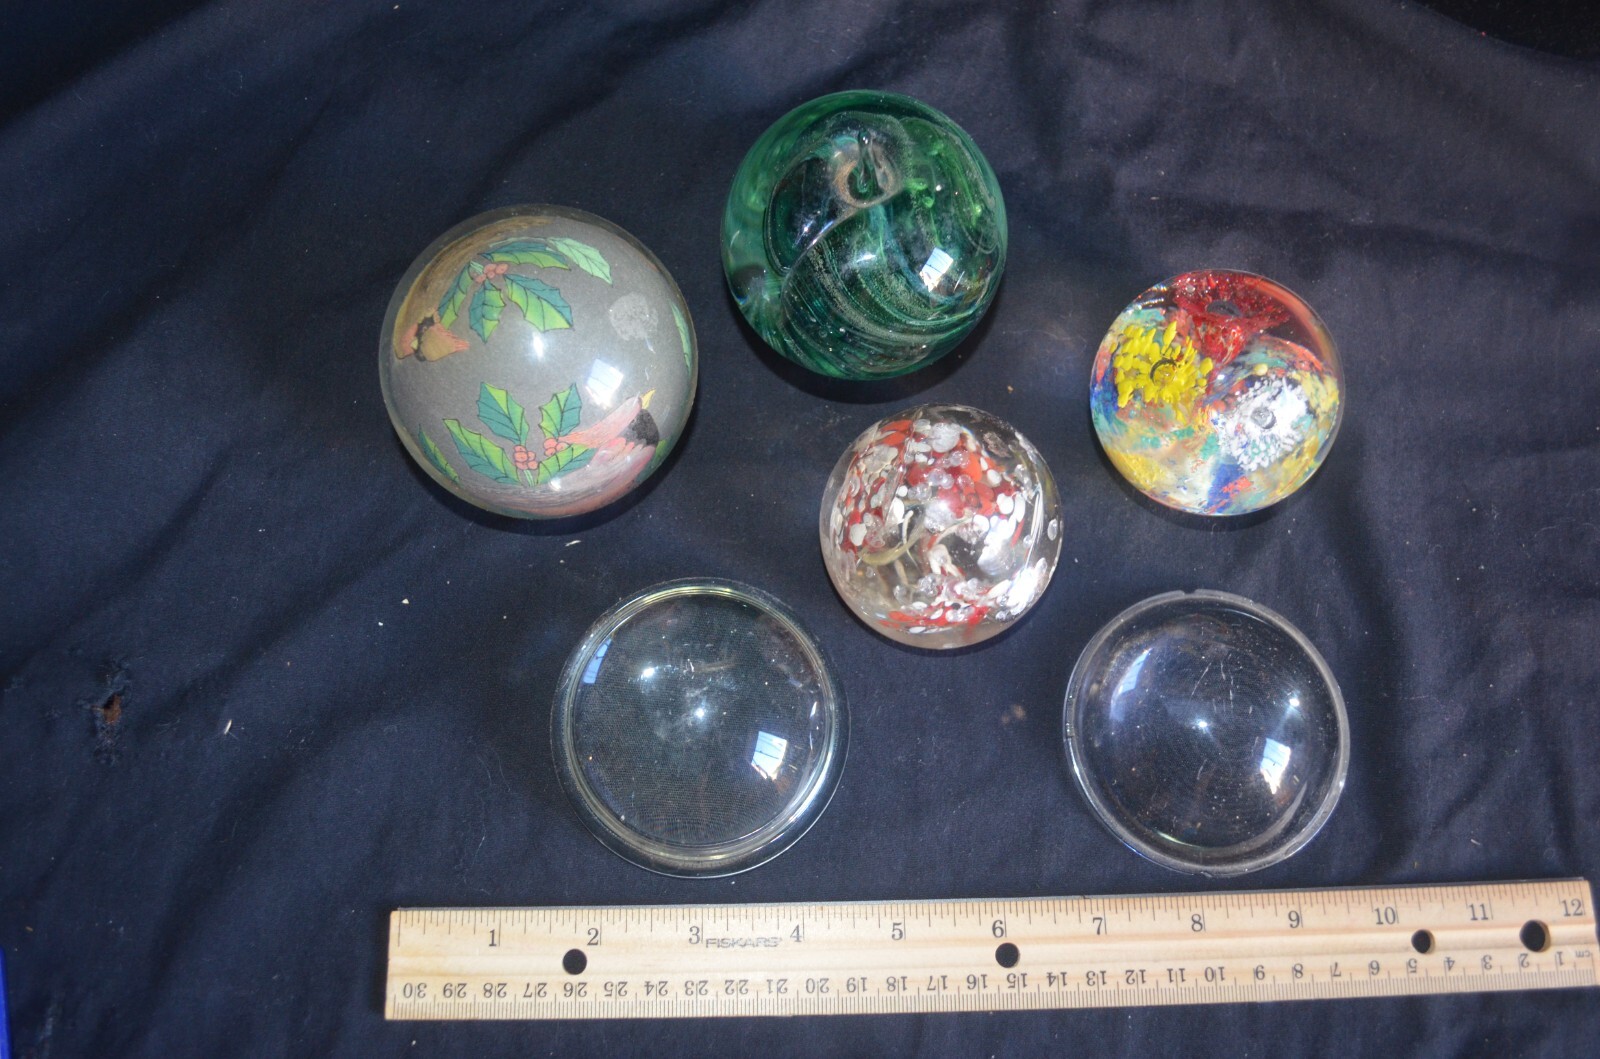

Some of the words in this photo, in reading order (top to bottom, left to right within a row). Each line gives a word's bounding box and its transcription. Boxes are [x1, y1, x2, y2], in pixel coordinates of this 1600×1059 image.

[489, 930, 497, 946] 1
[588, 928, 600, 946] 2
[688, 926, 700, 944] 3
[790, 924, 802, 942] 4
[892, 922, 904, 940] 5
[992, 920, 1004, 938] 6
[1093, 917, 1103, 935] 7
[1191, 914, 1203, 932] 8
[1288, 910, 1300, 928] 9
[1375, 906, 1396, 924] 10
[1469, 904, 1489, 921] 11
[1562, 899, 1583, 917] 12
[1520, 953, 1530, 968] 2
[1558, 952, 1564, 966] 1
[1576, 950, 1591, 958] cm
[1332, 962, 1342, 977] 7
[1370, 960, 1380, 975] 6
[1408, 958, 1418, 974] 5
[1446, 957, 1456, 971] 4
[1483, 955, 1492, 970] 3
[1086, 970, 1107, 986] 13
[1125, 969, 1146, 984] 12
[1166, 968, 1186, 983] 11
[1204, 966, 1226, 982] 10
[1254, 965, 1266, 980] 9
[1294, 964, 1304, 978] 8
[724, 979, 749, 996] 22
[766, 978, 788, 994] 21
[805, 978, 830, 994] 20
[846, 977, 868, 993] 19
[886, 976, 908, 992] 18
[927, 975, 948, 991] 17
[966, 974, 988, 990] 16
[1006, 972, 1028, 988] 15
[1046, 972, 1068, 987] 14
[403, 982, 426, 998] 30
[442, 982, 467, 998] 29
[483, 982, 508, 998] 28
[522, 982, 548, 998] 27
[563, 982, 588, 998] 26
[604, 981, 628, 997] 25
[644, 980, 668, 997] 24
[684, 980, 708, 996] 23
